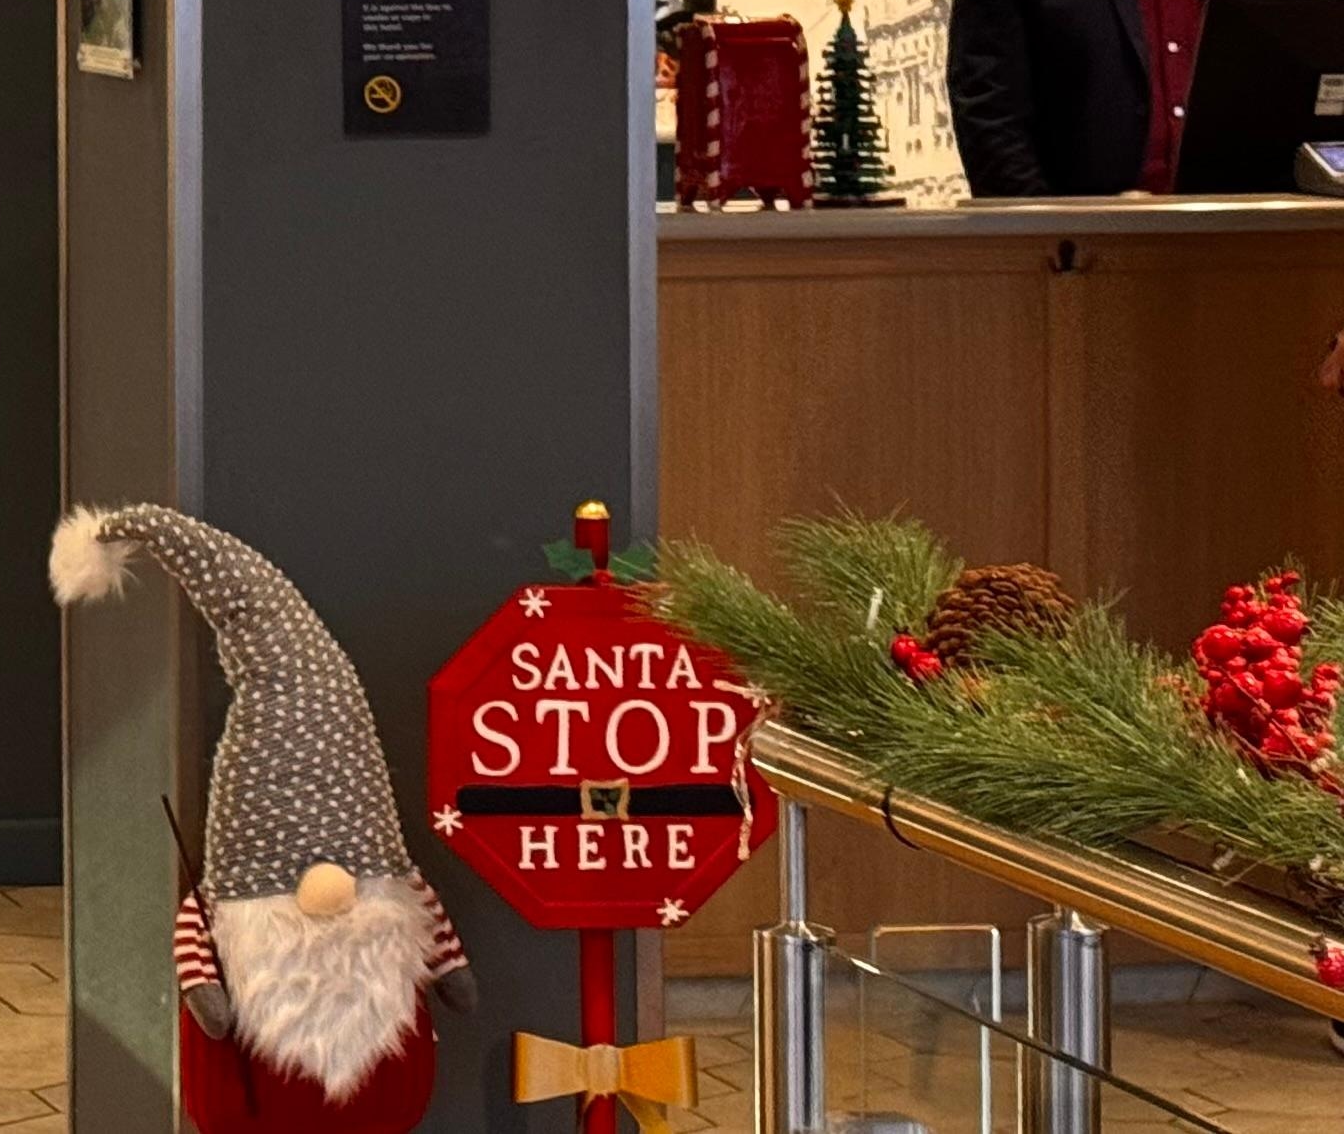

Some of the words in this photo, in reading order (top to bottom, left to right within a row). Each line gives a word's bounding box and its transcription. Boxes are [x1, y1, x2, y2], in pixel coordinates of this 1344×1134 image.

[511, 642, 704, 691] SANTA
[470, 699, 738, 777] STOP
[518, 823, 696, 870] HERE
